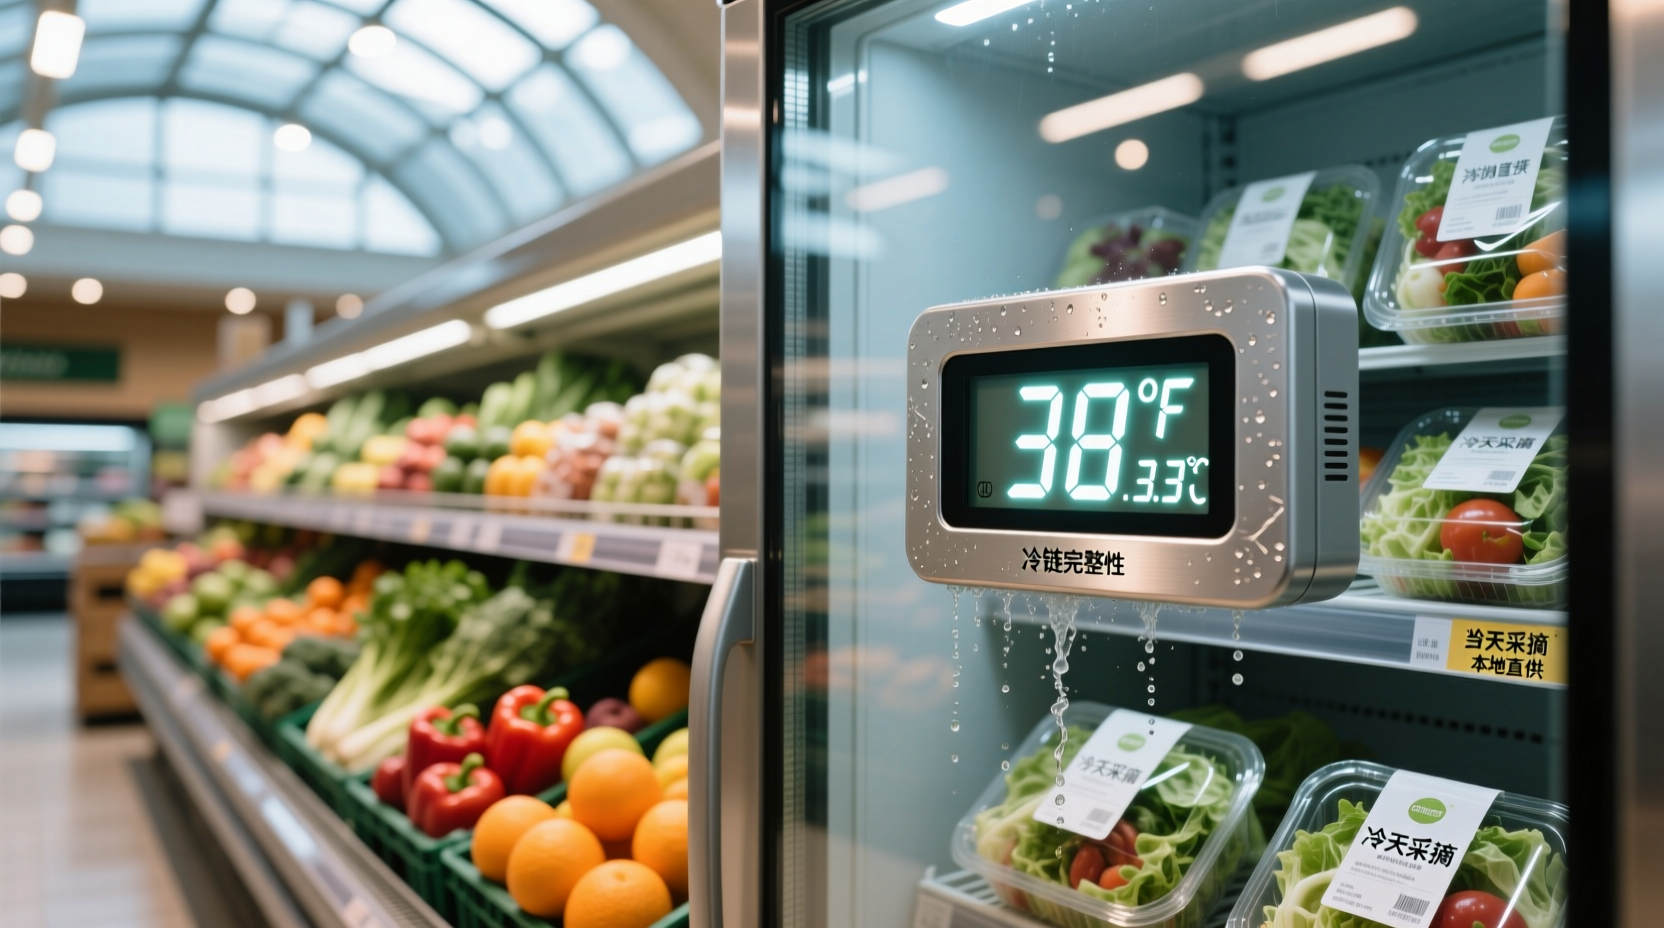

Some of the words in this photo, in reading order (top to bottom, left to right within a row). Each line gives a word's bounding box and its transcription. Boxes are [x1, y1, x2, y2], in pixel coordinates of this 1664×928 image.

[1021, 546, 1125, 576] 冷链完整性
[1464, 628, 1550, 657] 当天采摘
[1470, 653, 1544, 680] 本地直供
